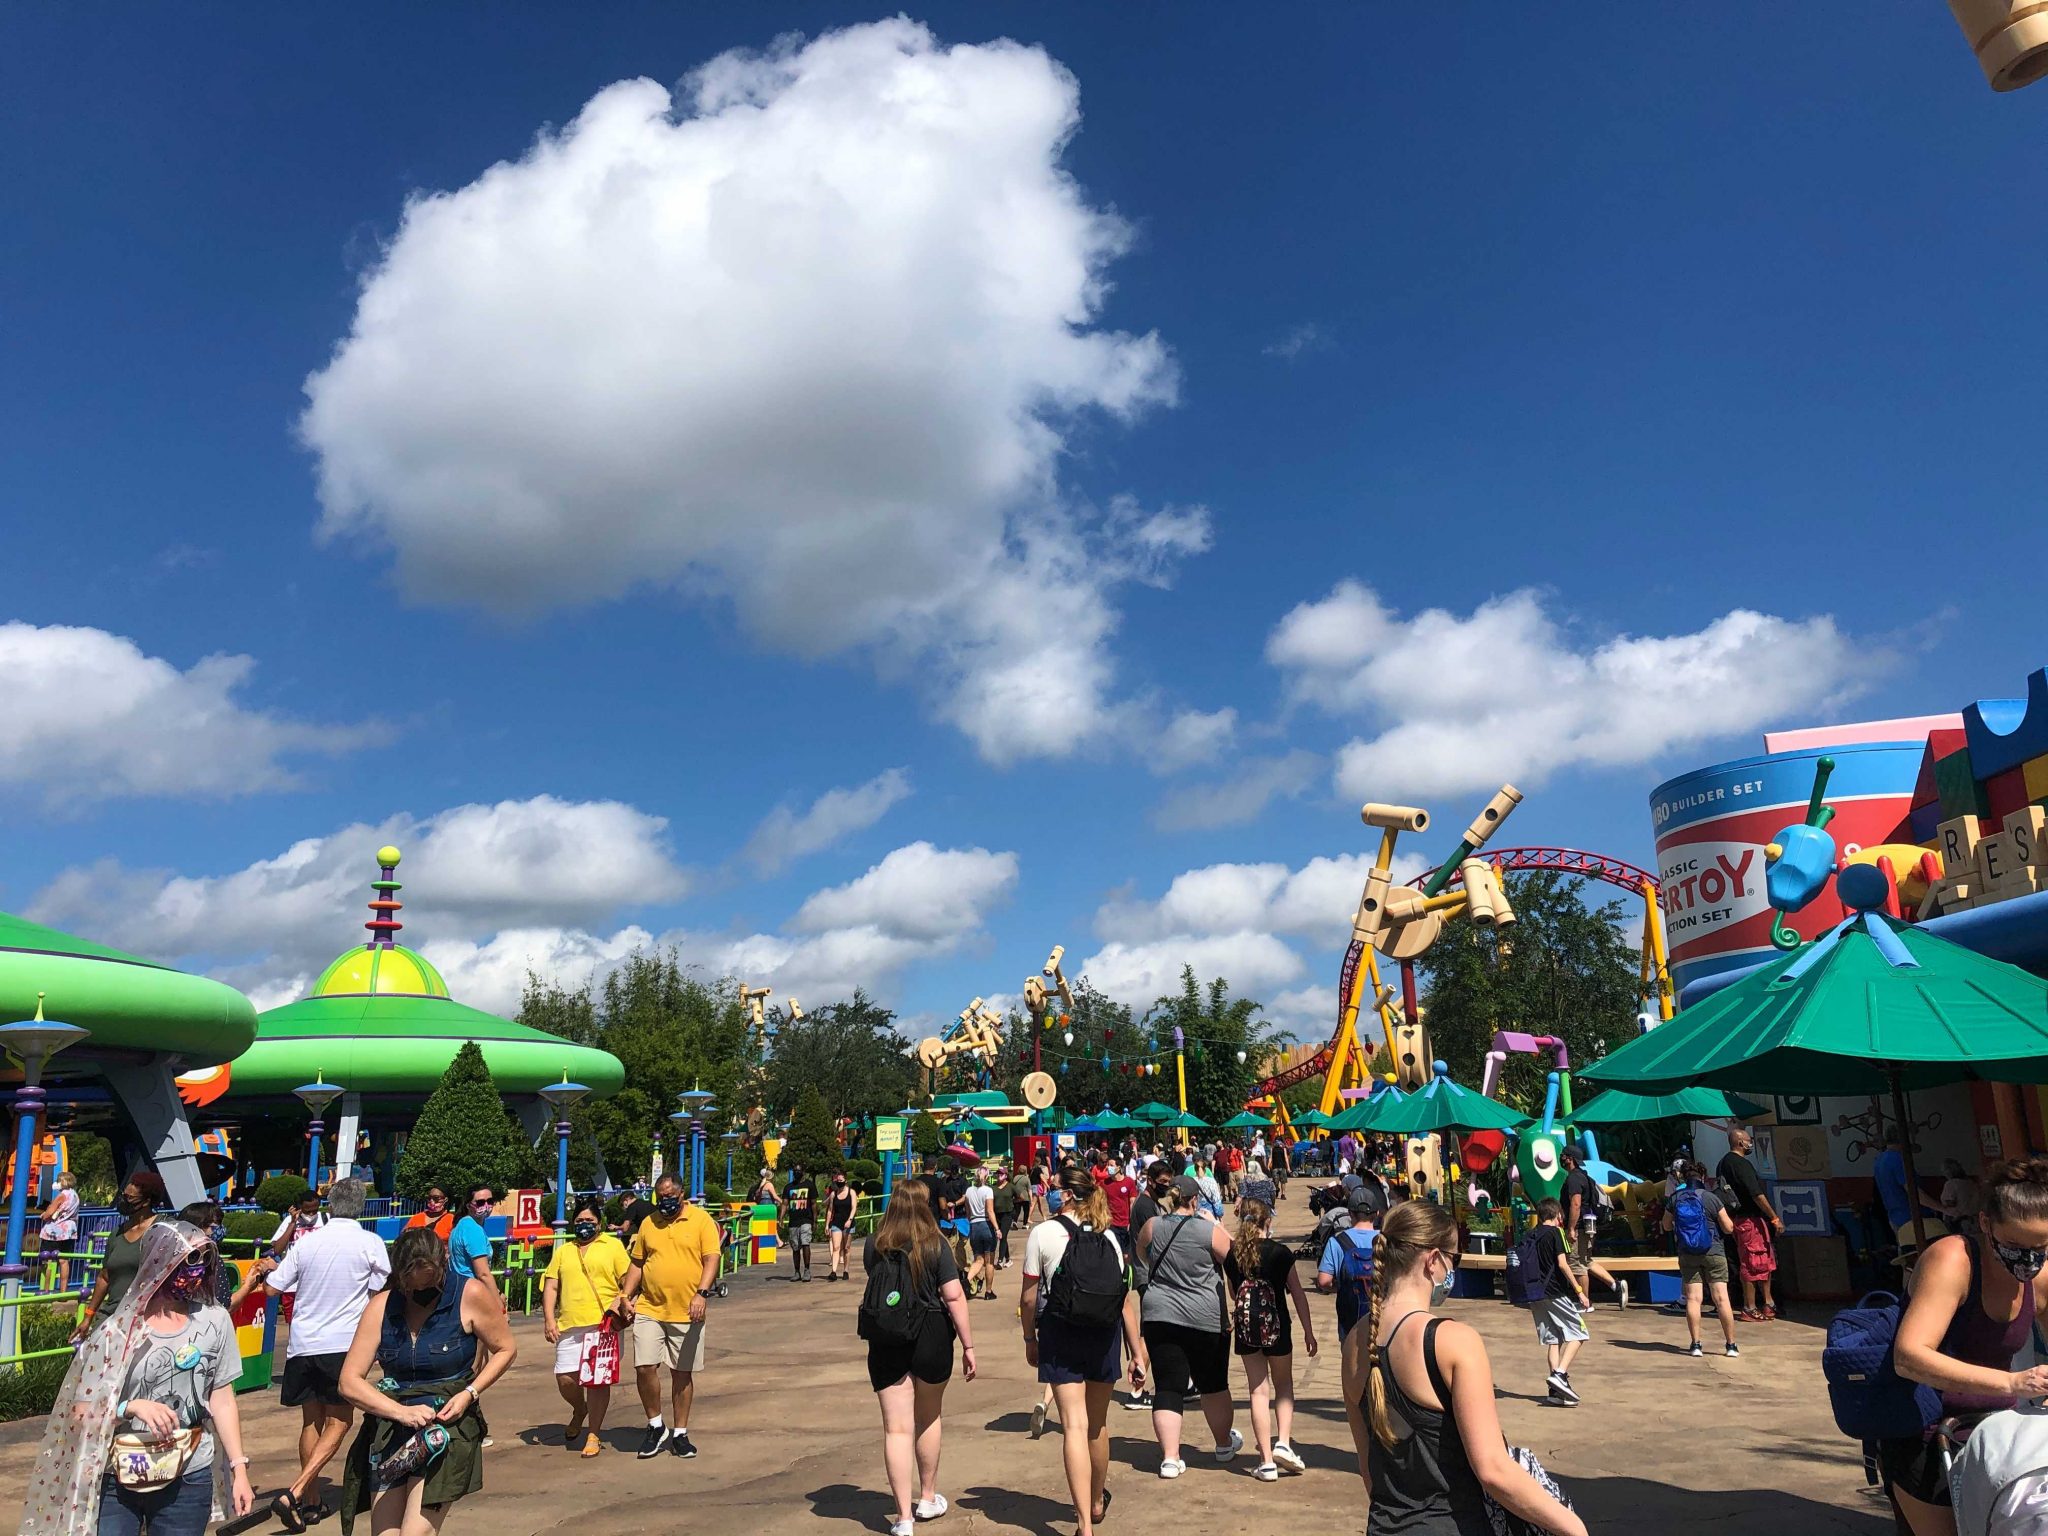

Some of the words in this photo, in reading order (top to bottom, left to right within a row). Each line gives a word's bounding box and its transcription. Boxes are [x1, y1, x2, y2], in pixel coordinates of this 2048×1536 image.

[1672, 788, 1725, 813] BUILDER
[1733, 780, 1763, 796] SET
[1667, 915, 1698, 936] CTION
[1701, 907, 1733, 923] SET
[522, 1197, 538, 1221] R
